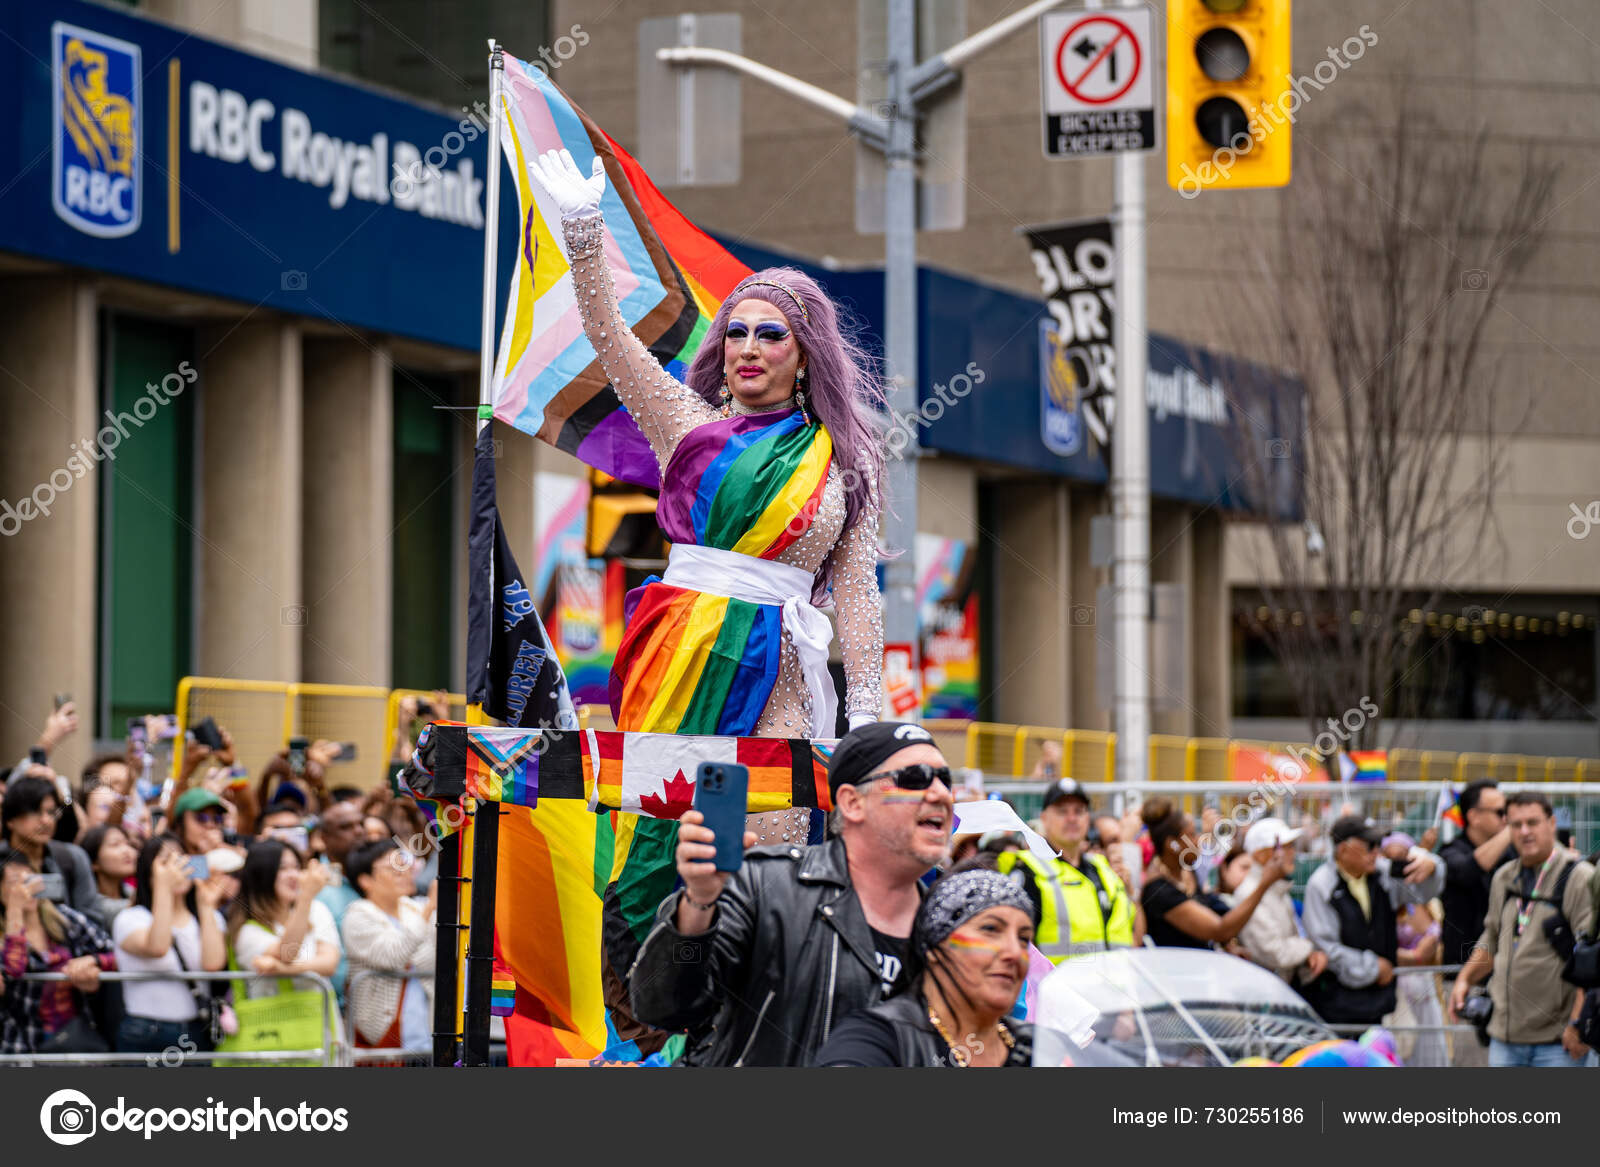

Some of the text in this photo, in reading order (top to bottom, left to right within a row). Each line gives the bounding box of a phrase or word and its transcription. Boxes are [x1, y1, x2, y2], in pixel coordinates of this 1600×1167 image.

[1060, 111, 1142, 134] BICYCLES
[188, 81, 484, 230] RBC Royal Bank
[65, 165, 132, 221] RBC
[1146, 365, 1184, 423] oyal
